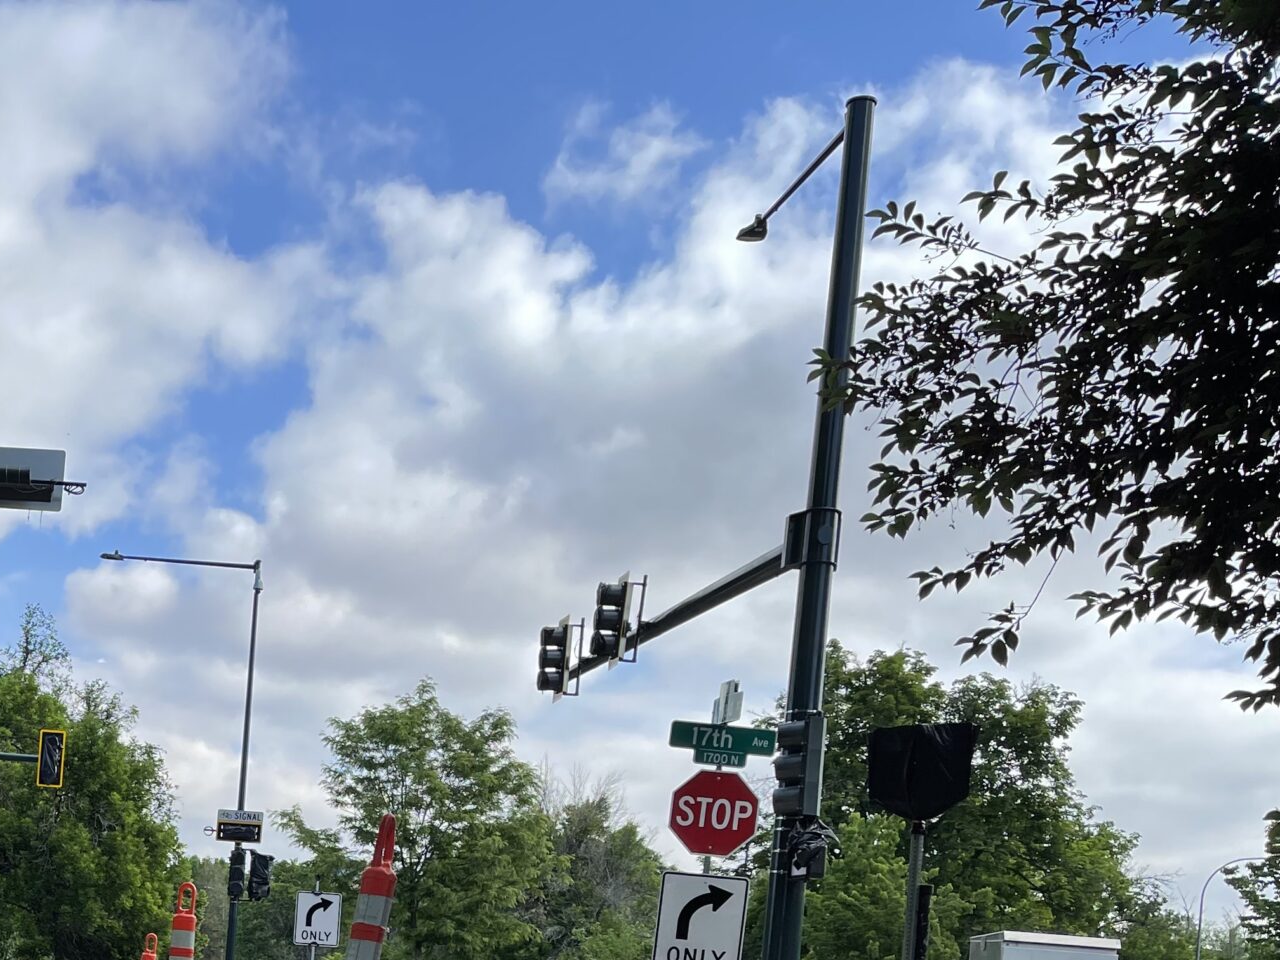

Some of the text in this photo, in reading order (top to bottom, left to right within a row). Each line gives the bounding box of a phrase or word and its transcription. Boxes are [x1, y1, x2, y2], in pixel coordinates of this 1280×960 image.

[693, 727, 769, 749] 17th Ave
[703, 752, 739, 765] 1700 N
[234, 811, 261, 821] SIGNAL
[676, 796, 753, 831] STOP
[301, 930, 332, 942] ONLY
